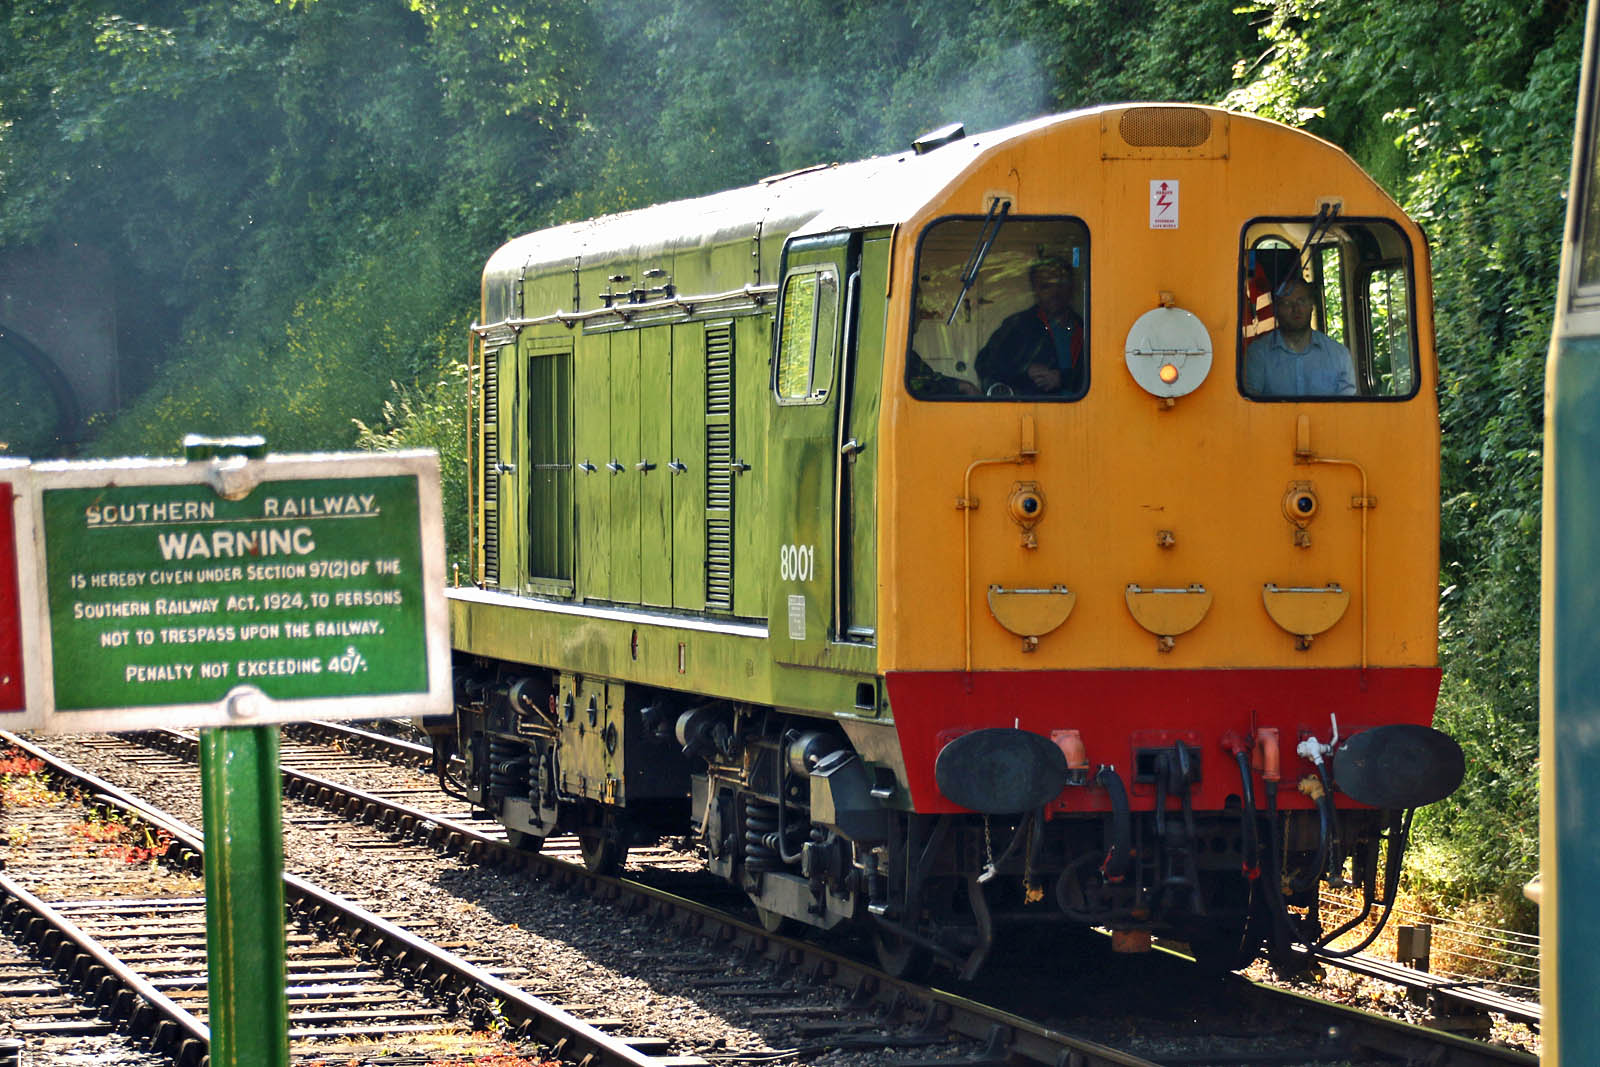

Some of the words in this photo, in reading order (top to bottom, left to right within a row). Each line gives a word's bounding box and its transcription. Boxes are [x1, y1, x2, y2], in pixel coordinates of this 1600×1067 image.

[86, 502, 214, 524] SOUTHERN
[158, 527, 316, 561] WARNING
[71, 573, 87, 589] IS
[91, 572, 146, 588] HEREBY
[150, 569, 193, 585] GIVEN
[196, 566, 243, 583] UNDER
[246, 563, 306, 580] SECTION
[375, 559, 401, 575] THE
[780, 544, 815, 582] 8001
[74, 602, 150, 619] SOUTHERN
[155, 598, 219, 615] RAILWAY
[263, 592, 308, 610] 1924,
[311, 592, 330, 608] TO
[335, 590, 403, 607] PERSONS
[101, 631, 130, 648] NOT
[135, 629, 155, 645] TO
[160, 626, 236, 644] TRESPASS
[240, 625, 280, 641] UPON
[284, 623, 312, 639] THE
[125, 664, 194, 683] PENALTY
[200, 661, 230, 679] NOT
[237, 657, 322, 677] EXCEEDING
